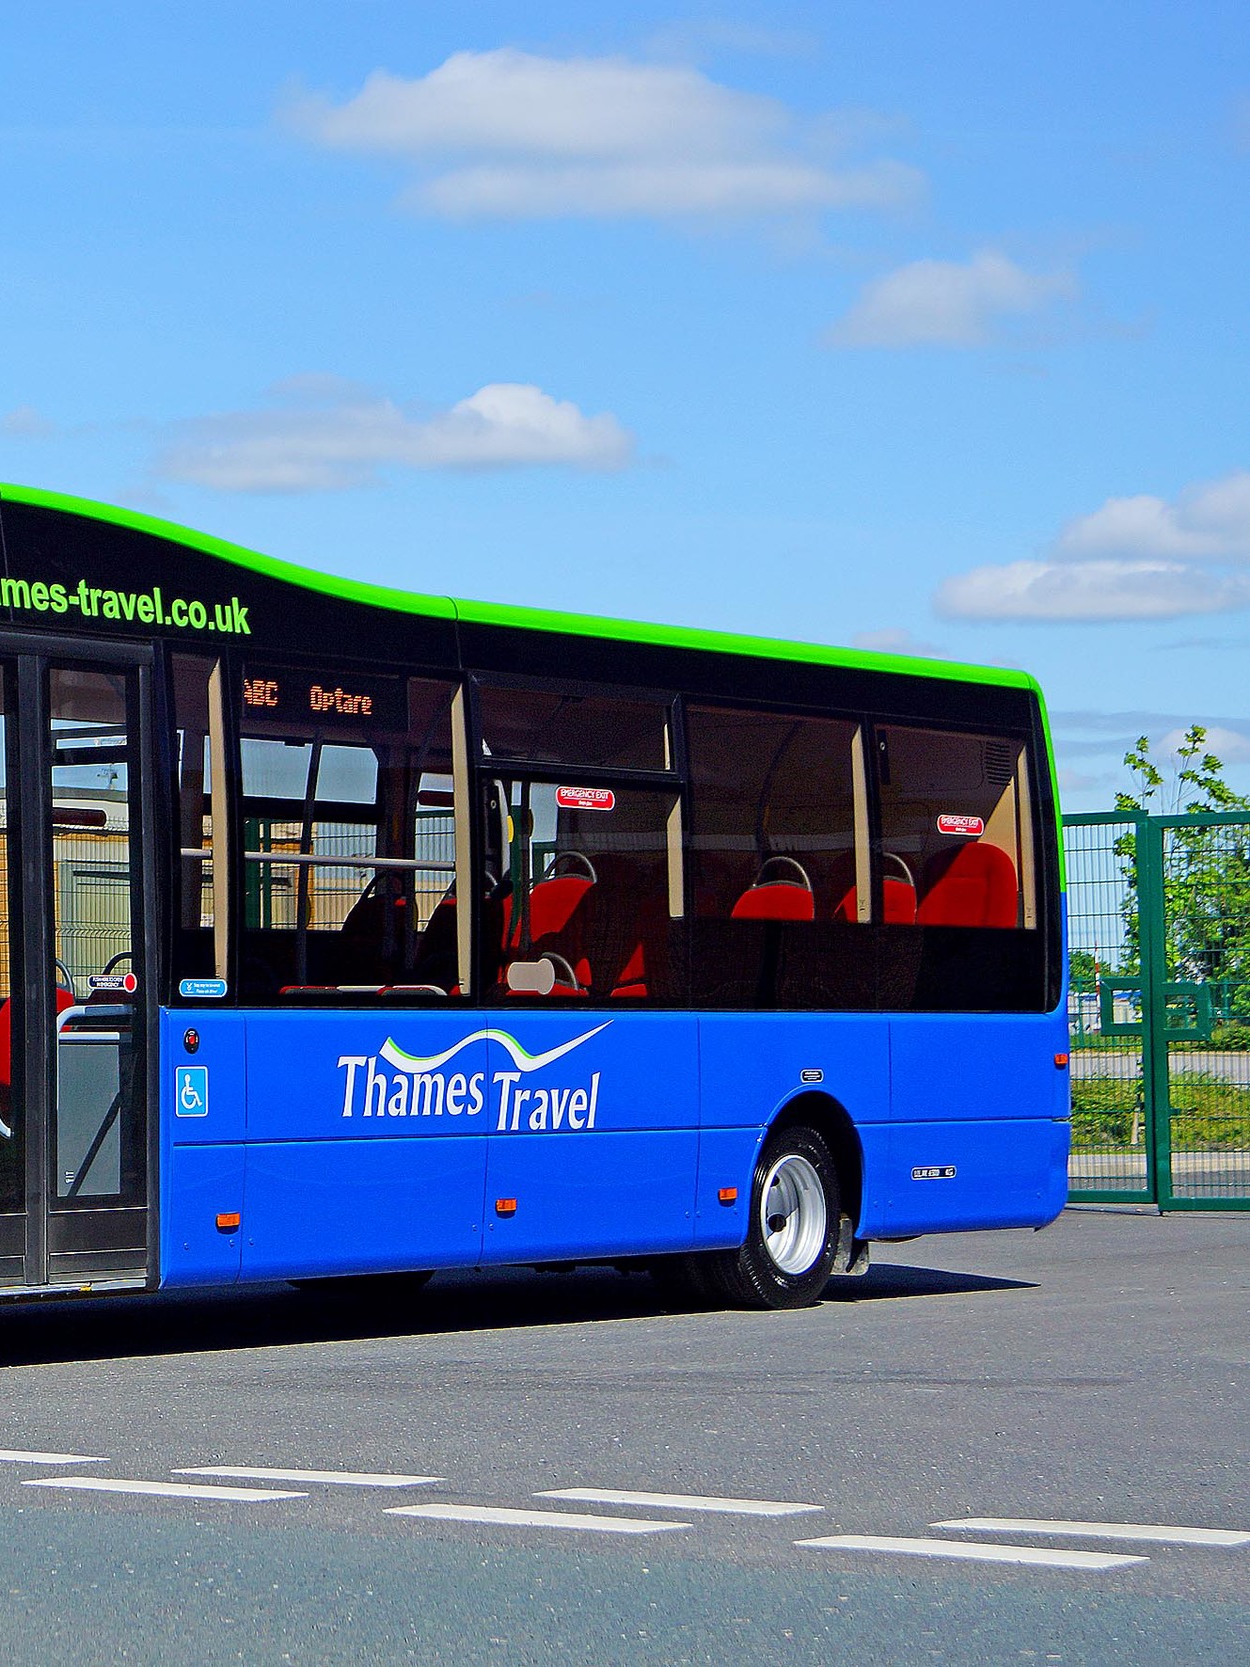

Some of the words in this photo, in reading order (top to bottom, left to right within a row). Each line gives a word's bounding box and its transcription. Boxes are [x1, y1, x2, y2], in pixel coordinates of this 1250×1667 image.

[310, 686, 372, 714] Optare
[337, 1056, 484, 1117] Thames
[492, 1071, 601, 1131] Travel
